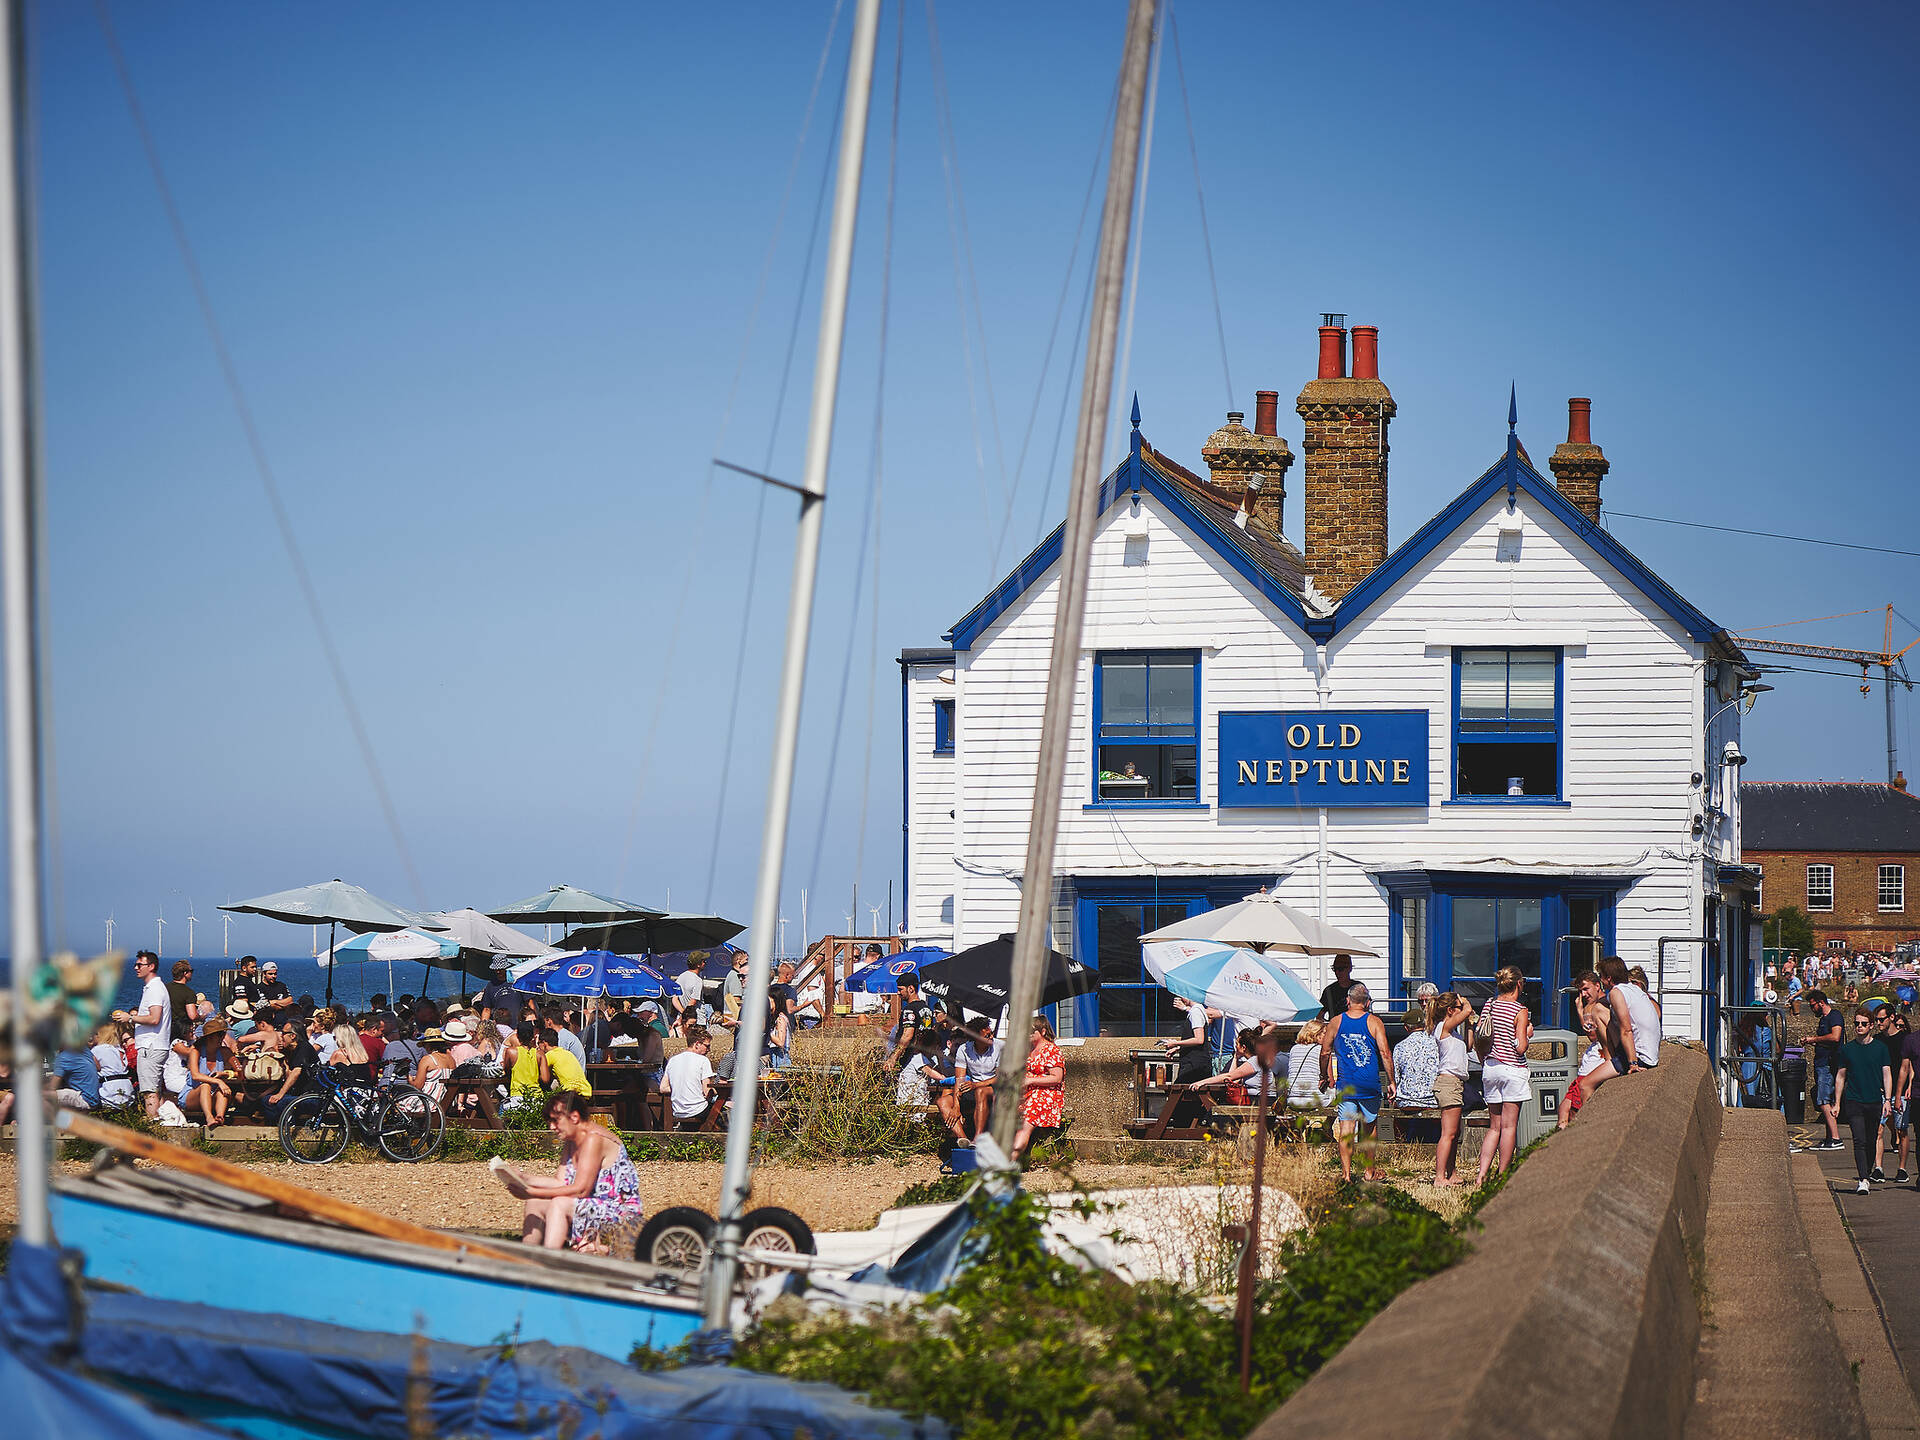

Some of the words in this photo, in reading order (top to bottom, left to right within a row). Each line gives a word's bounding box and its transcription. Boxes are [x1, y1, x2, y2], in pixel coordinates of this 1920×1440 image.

[1286, 724, 1362, 749] OLD
[1237, 759, 1411, 785] NEPTUNE
[921, 980, 950, 996] Asahi
[976, 984, 1007, 997] Asahi
